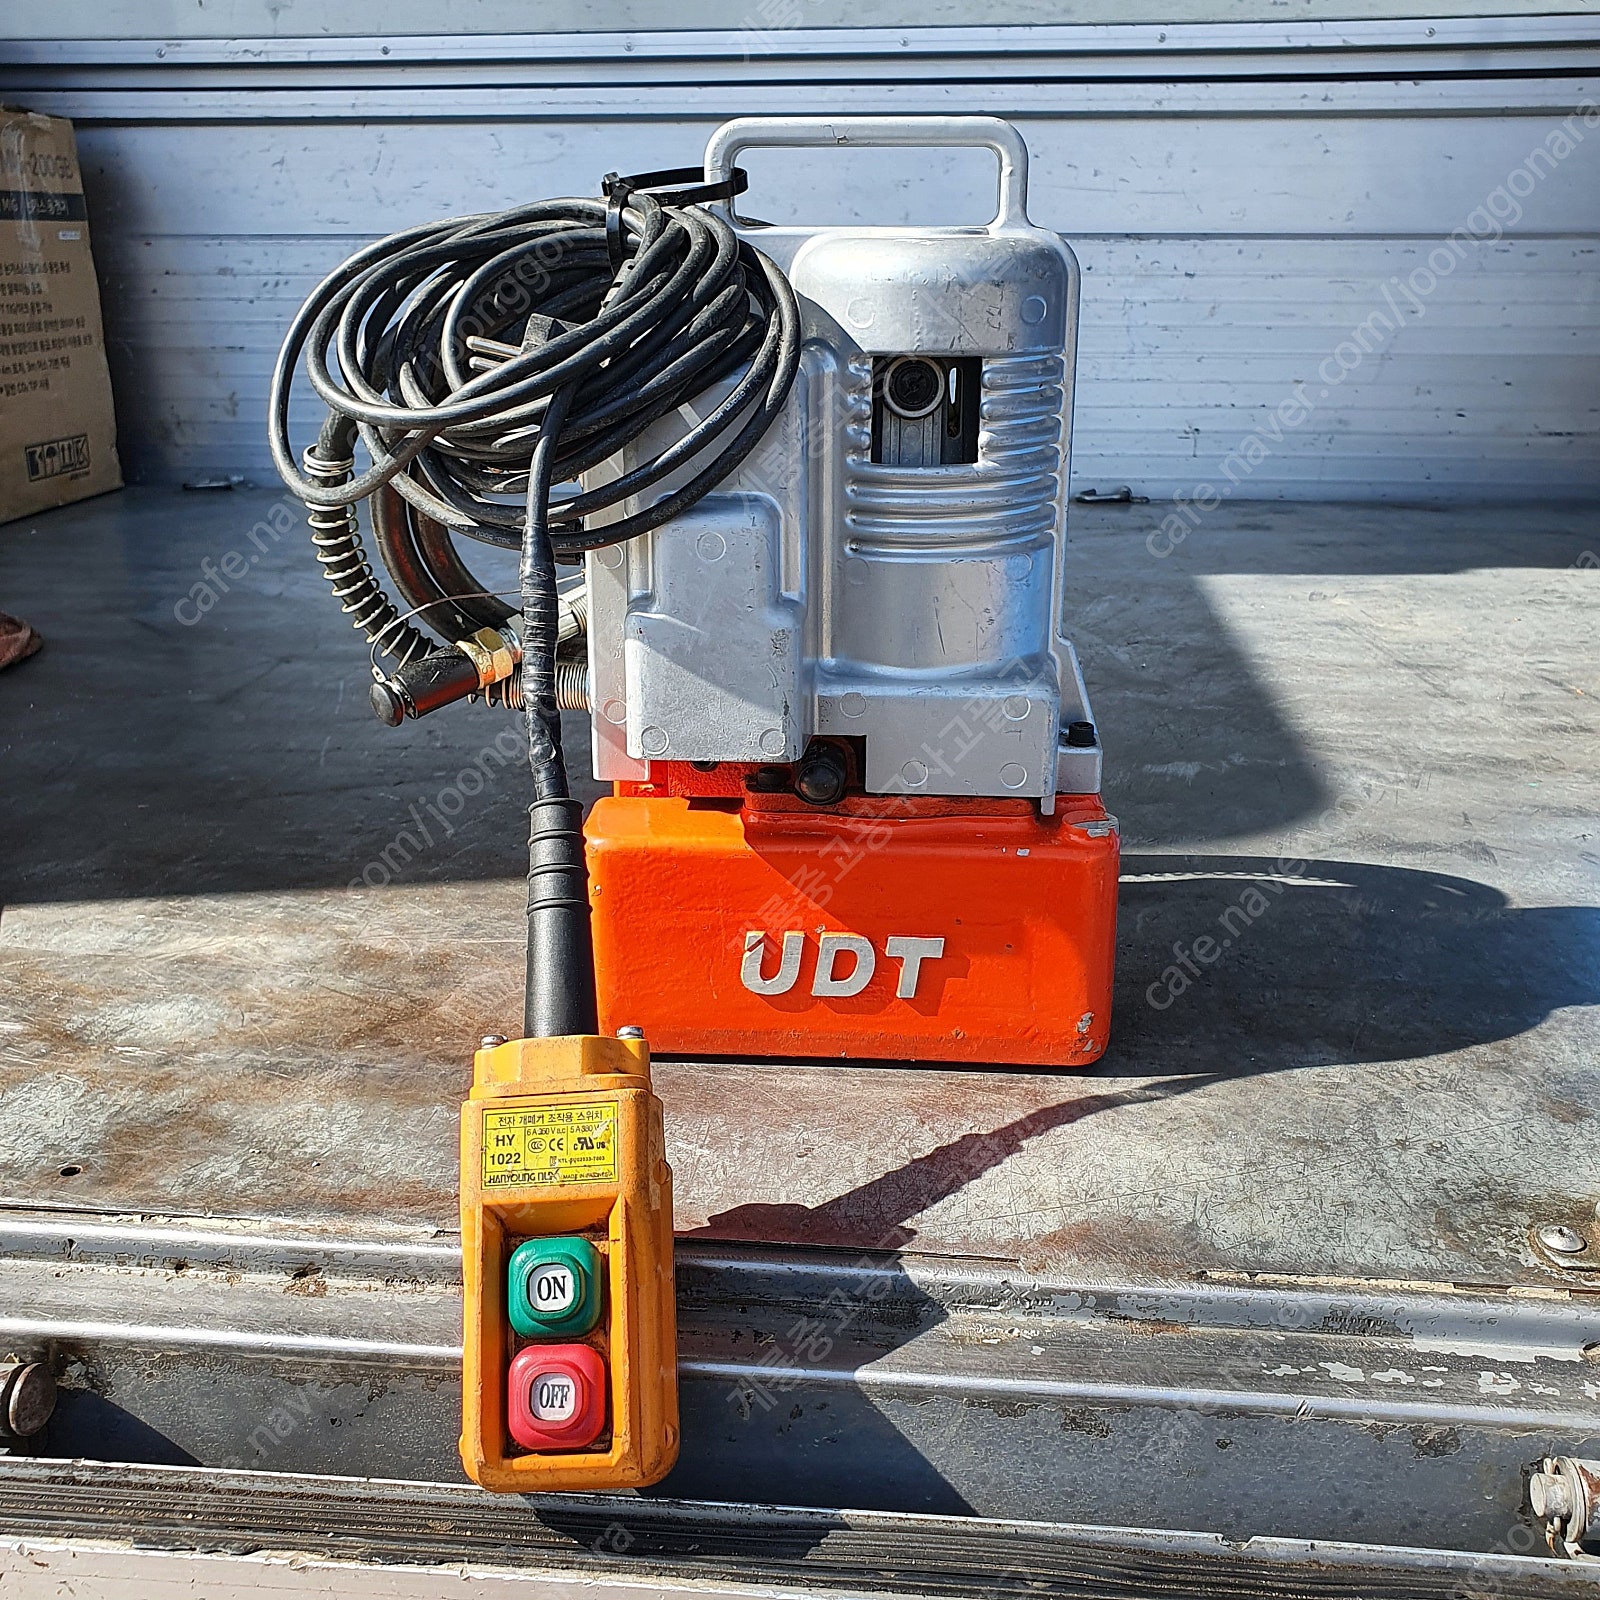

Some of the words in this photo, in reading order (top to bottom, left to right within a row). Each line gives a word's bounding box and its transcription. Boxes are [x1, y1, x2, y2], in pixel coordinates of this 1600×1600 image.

[740, 930, 946, 999] UDT
[498, 1115, 515, 1126] 전자
[548, 1111, 573, 1123] 조작용
[577, 1109, 602, 1121] 스위치
[495, 1134, 516, 1147] HY
[490, 1152, 521, 1165] 1022
[537, 1275, 566, 1301] ON
[539, 1383, 570, 1409] OFF
